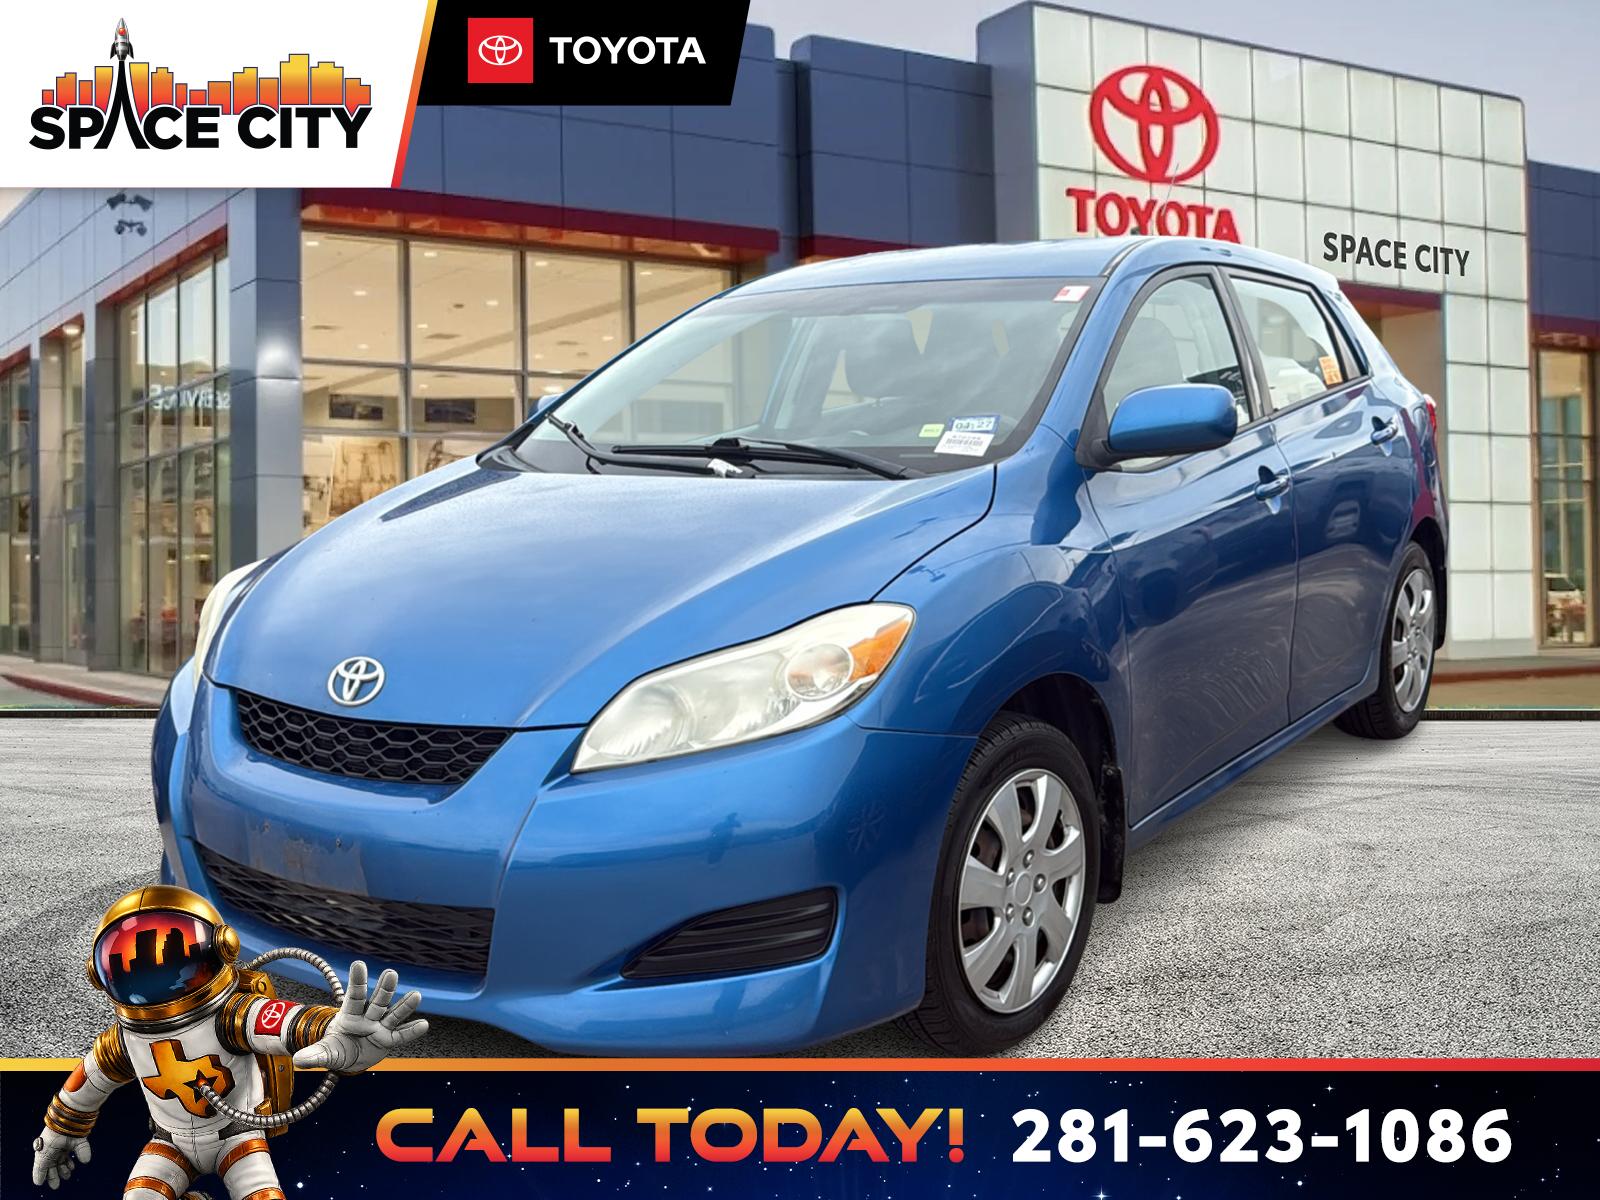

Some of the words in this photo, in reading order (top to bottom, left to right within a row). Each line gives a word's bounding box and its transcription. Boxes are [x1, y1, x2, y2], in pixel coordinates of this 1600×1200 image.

[1066, 188, 1241, 244] TOYOTA
[1323, 232, 1407, 270] SPACE
[1414, 244, 1470, 277] CITY
